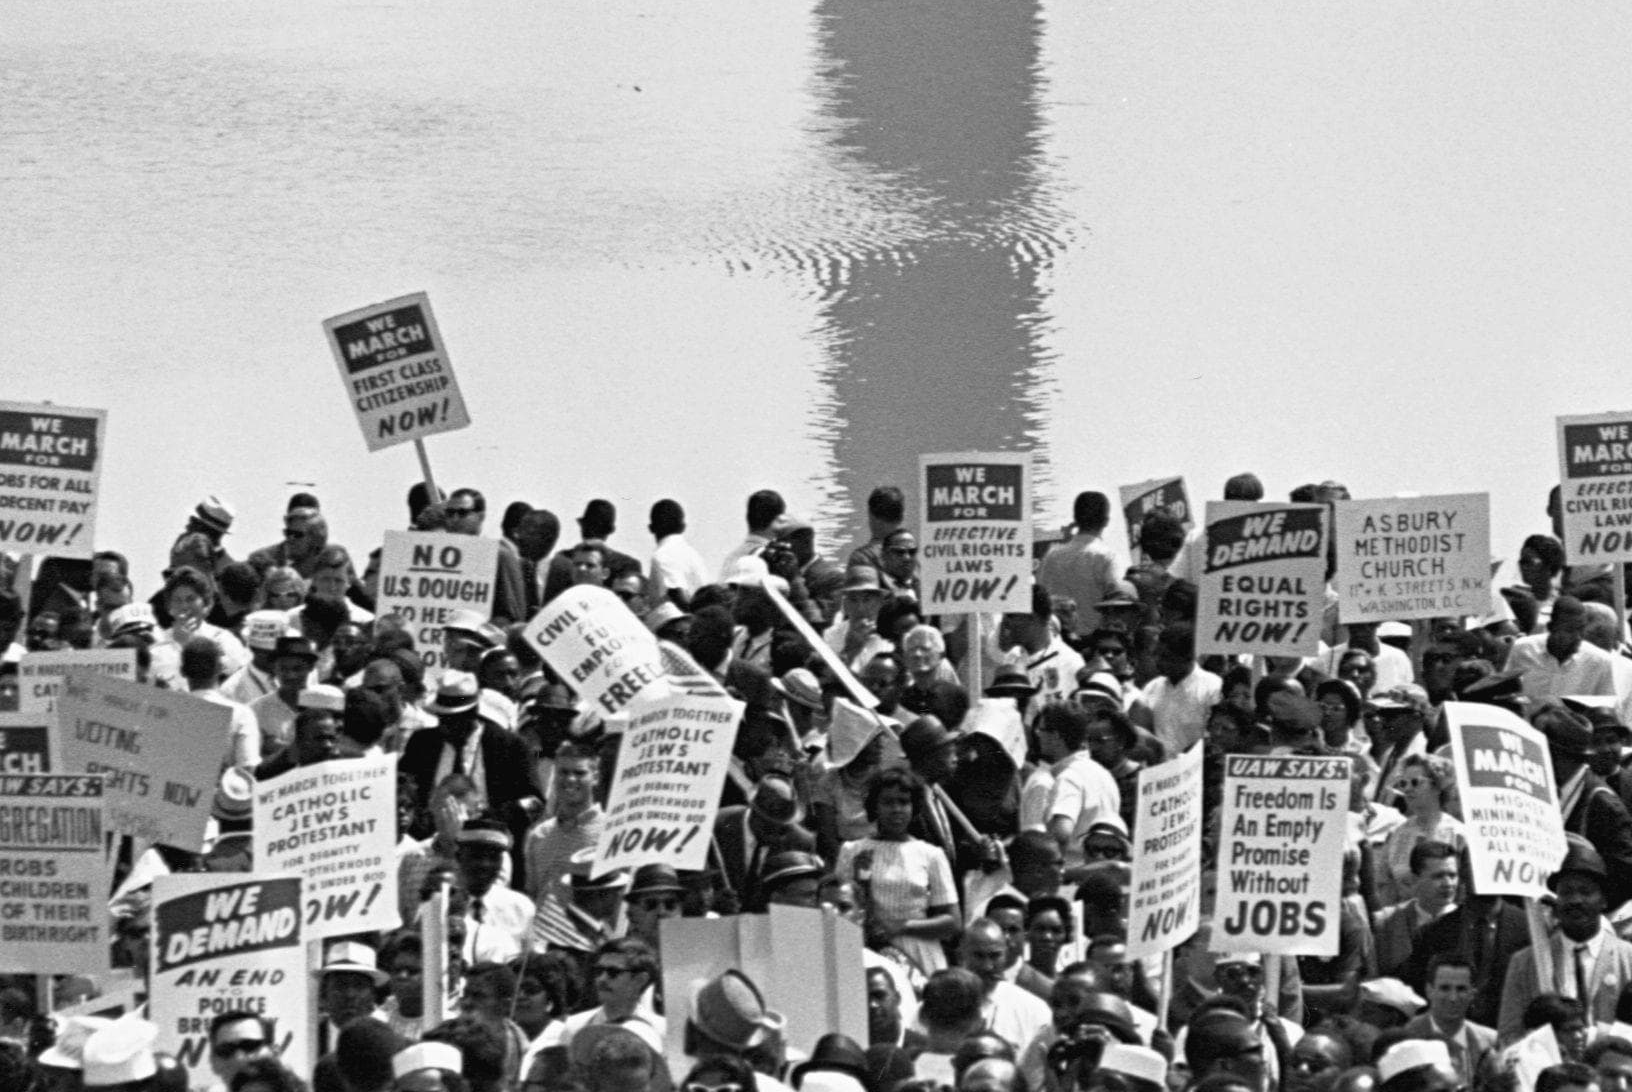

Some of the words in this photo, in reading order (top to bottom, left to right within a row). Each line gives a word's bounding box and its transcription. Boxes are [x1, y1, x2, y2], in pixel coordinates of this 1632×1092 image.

[366, 314, 396, 333] WE
[348, 323, 425, 360] MARCH
[353, 370, 396, 395] FIRST
[400, 358, 442, 380] CLASS
[356, 375, 449, 412] CITIZENSHIP
[31, 417, 63, 434] WE
[378, 397, 449, 438] NOW!
[0, 431, 89, 456] MARCH
[1598, 425, 1630, 441] WE
[24, 454, 61, 467] FOR
[30, 475, 60, 491] FOR
[64, 477, 92, 494] ALL
[955, 466, 987, 484] WE
[58, 500, 91, 514] PAY
[931, 485, 1016, 507] MARCH
[1566, 498, 1608, 514] CIVIL
[953, 506, 988, 518] FOR
[933, 526, 1019, 541] EFFECTIVE
[1242, 512, 1288, 539] WE
[1362, 510, 1458, 539] ASBURY
[923, 544, 958, 558] CIVIL
[961, 543, 1026, 558] RIGHTS
[1211, 529, 1319, 567] DEMAND
[1355, 533, 1466, 557] METHODIST
[412, 544, 463, 569] NO
[945, 559, 995, 573] LAWS
[1361, 557, 1446, 579] CHURCH
[383, 575, 414, 598] U.S.
[417, 576, 490, 604] DOUGH
[932, 574, 1019, 603] NOW!
[1222, 575, 1307, 596] EQUAL
[1396, 578, 1455, 596] STREETS
[1218, 597, 1309, 619] RIGHTS
[536, 610, 579, 647] CIVIL
[1214, 621, 1309, 644] NOW!
[672, 707, 733, 724] TOGETHER
[75, 718, 141, 754] VOTING
[631, 726, 715, 749] CATHOLIC
[638, 743, 690, 761] JEWS
[620, 759, 712, 783] PROTESTANT
[1231, 758, 1282, 777] UAW
[1284, 760, 1347, 779] SAYS:
[1473, 748, 1547, 788] MARCH
[259, 789, 275, 806] WE
[279, 776, 318, 797] MARCH
[322, 766, 388, 786] TOGETHER
[644, 781, 691, 794] DIGNITY
[1235, 784, 1315, 810] Freedom
[1320, 787, 1337, 810] Is
[272, 786, 372, 822] CATHOLIC
[628, 795, 707, 810] BROTHERHOOD
[290, 806, 349, 833] JEWS
[646, 810, 682, 823] UNDER
[685, 813, 707, 824] GOD
[267, 818, 377, 857] PROTESTANT
[1232, 813, 1258, 837] An
[1265, 813, 1325, 844] Empty
[605, 824, 700, 859] NOW!
[310, 843, 360, 863] DIGNITY
[1231, 841, 1311, 866] Promise
[0, 880, 90, 900] CHILDREN
[320, 874, 357, 889] UNDER
[363, 870, 387, 884] GOD
[1230, 869, 1311, 894] Without
[1, 904, 25, 920] OF
[33, 903, 91, 922] THEIR
[205, 884, 262, 923] WE
[1224, 899, 1327, 937] JOBS
[2, 923, 100, 943] BIRTHRIGHT
[164, 906, 297, 964] DEMAND
[174, 968, 221, 987] AN
[229, 968, 285, 986] END
[199, 996, 267, 1015] POLICE
